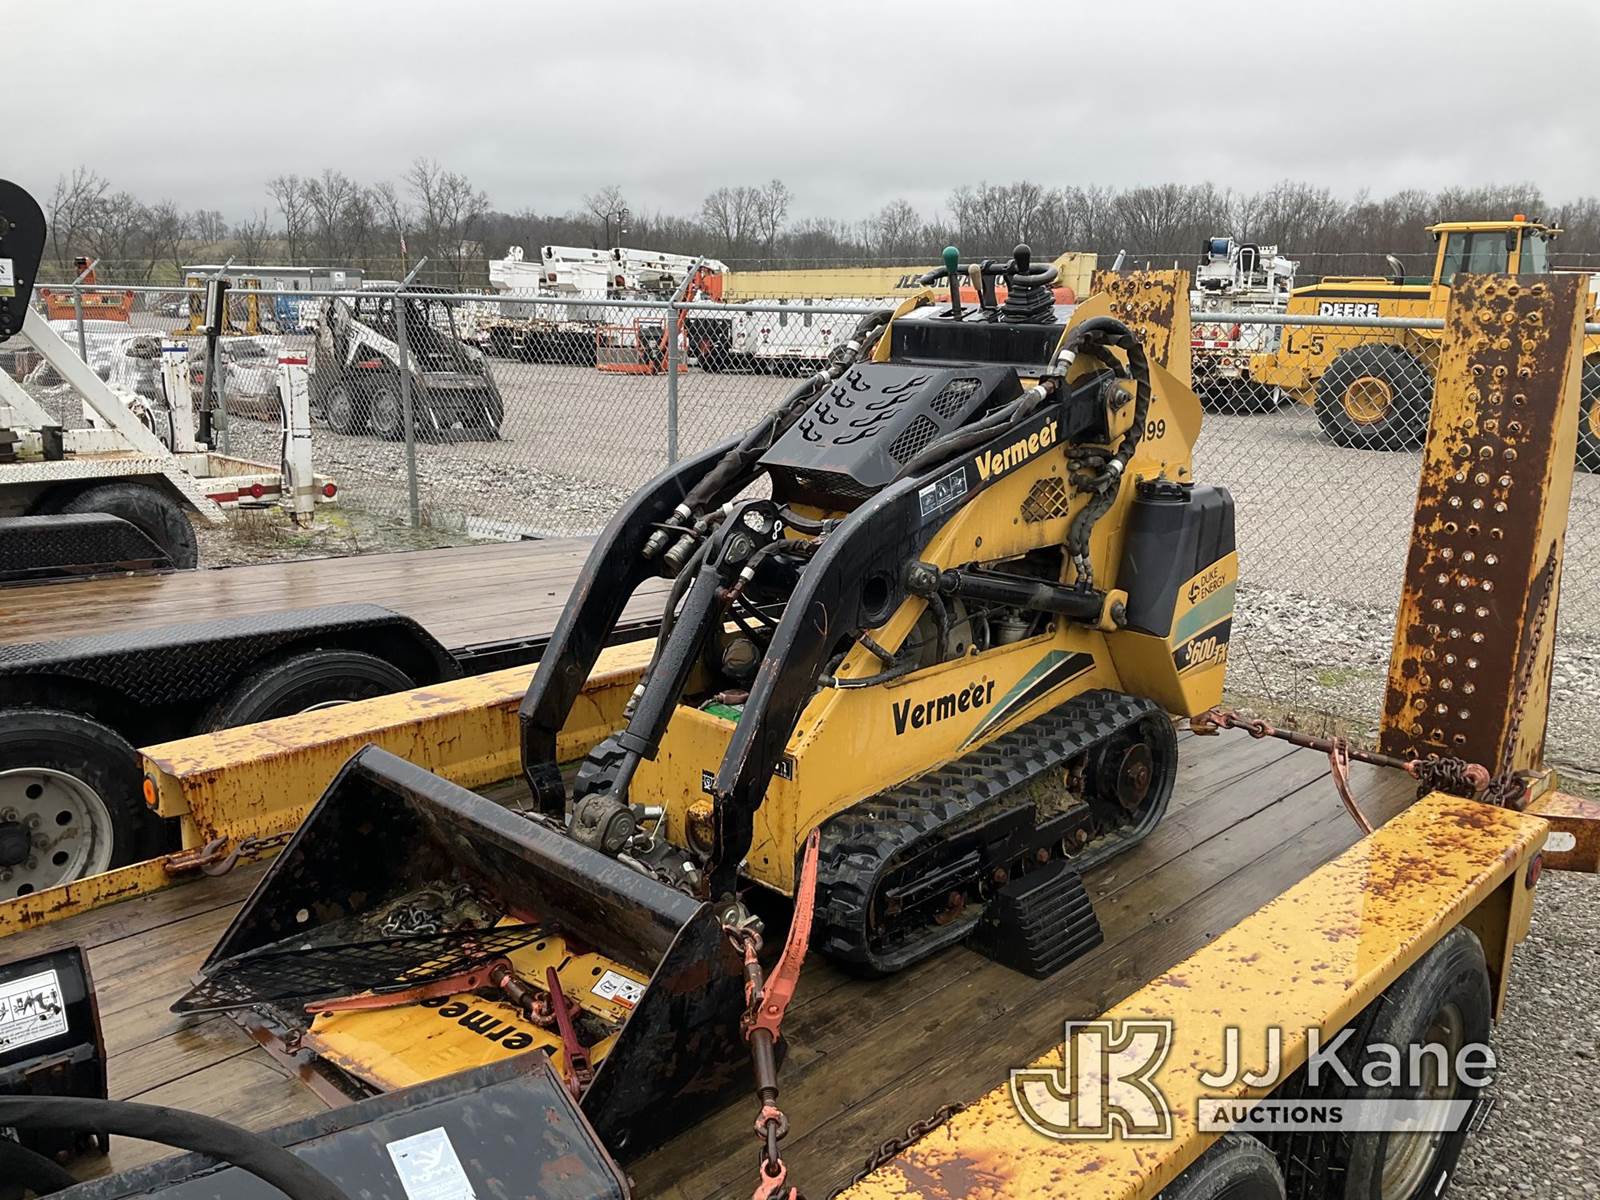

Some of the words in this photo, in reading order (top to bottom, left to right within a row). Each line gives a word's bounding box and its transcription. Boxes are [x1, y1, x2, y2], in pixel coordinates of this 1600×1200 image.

[1318, 302, 1379, 318] DEERE
[1287, 334, 1325, 355] L-5
[974, 419, 1058, 481] Vermeer
[1200, 567, 1218, 587] DUKE
[1200, 573, 1226, 599] ENERGY
[892, 679, 996, 735] Vermeer
